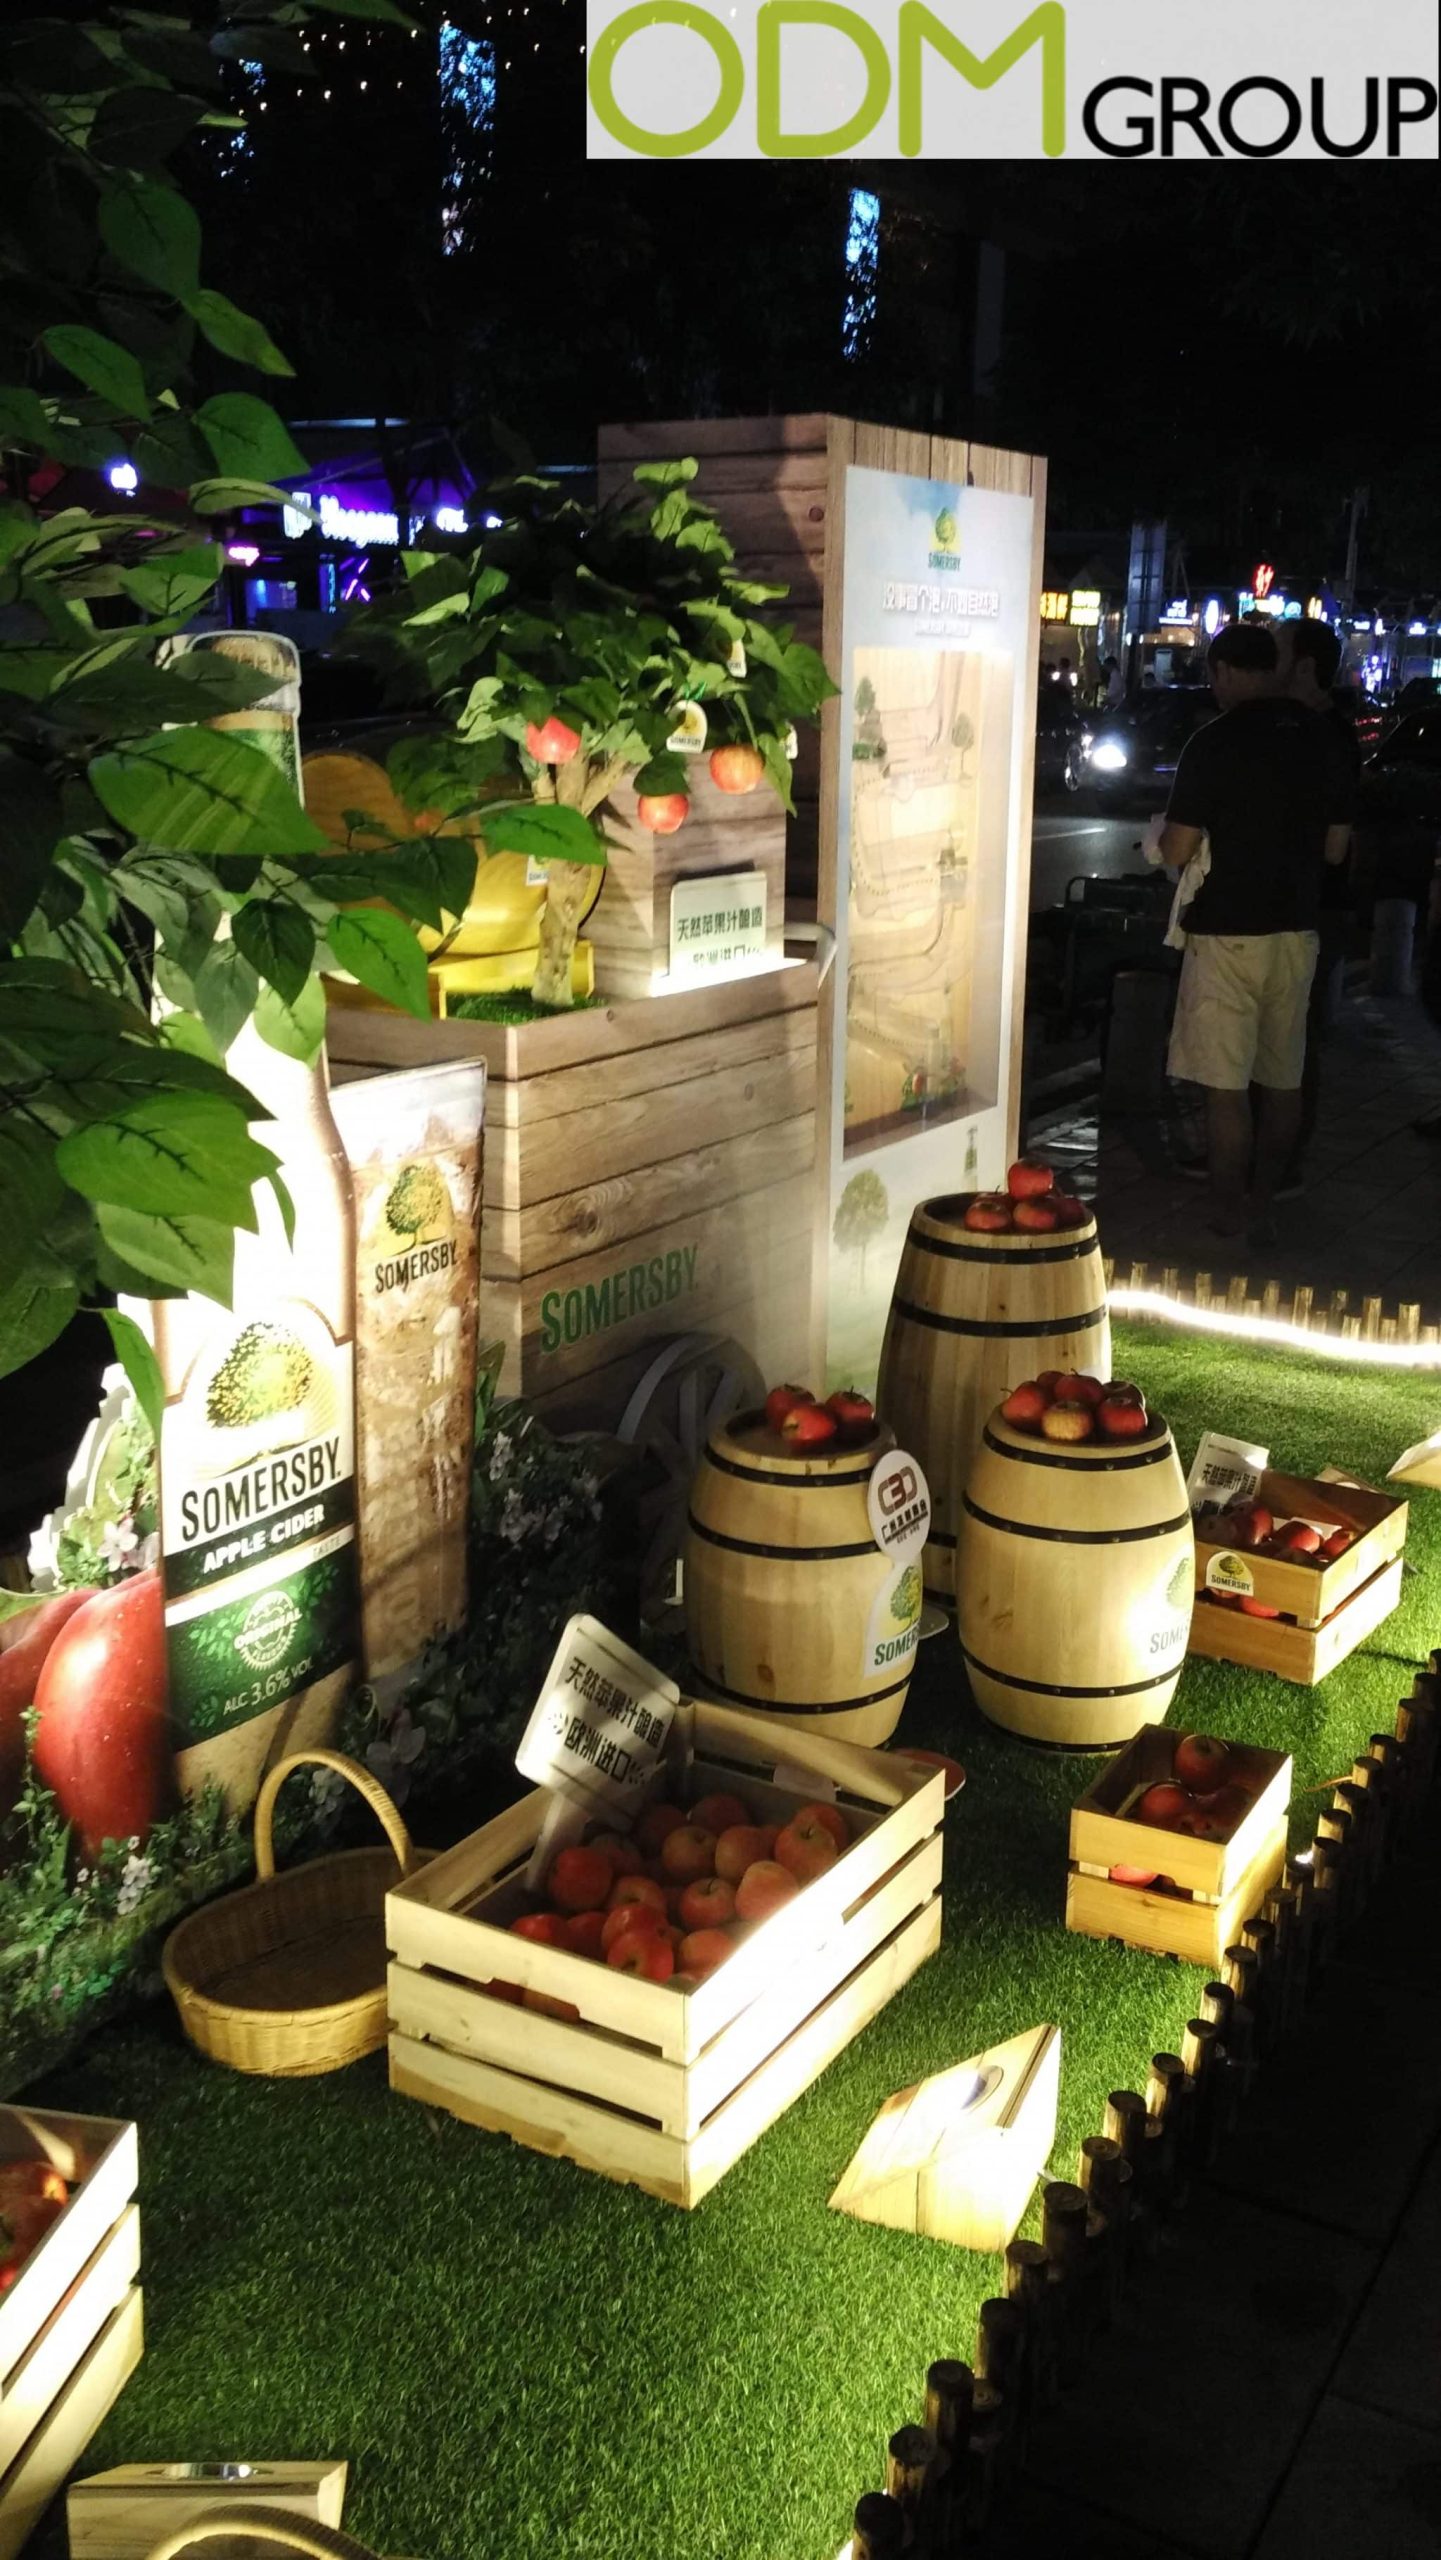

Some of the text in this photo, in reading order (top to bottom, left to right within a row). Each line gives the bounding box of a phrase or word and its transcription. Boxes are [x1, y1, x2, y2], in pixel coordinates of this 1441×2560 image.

[928, 552, 961, 571] SOMERSBY
[374, 1239, 457, 1293] SOMERSBY
[541, 1241, 698, 1354] SOMERSBY
[203, 1503, 325, 1575] APPLE CIDER
[1210, 1573, 1251, 1593] SOMERSBY
[223, 1691, 249, 1716] ALC
[251, 1669, 291, 1706] 3.6%
[565, 1656, 665, 1748] 天然苹果汁酿造
[564, 1716, 633, 1784] 欧洲进口
